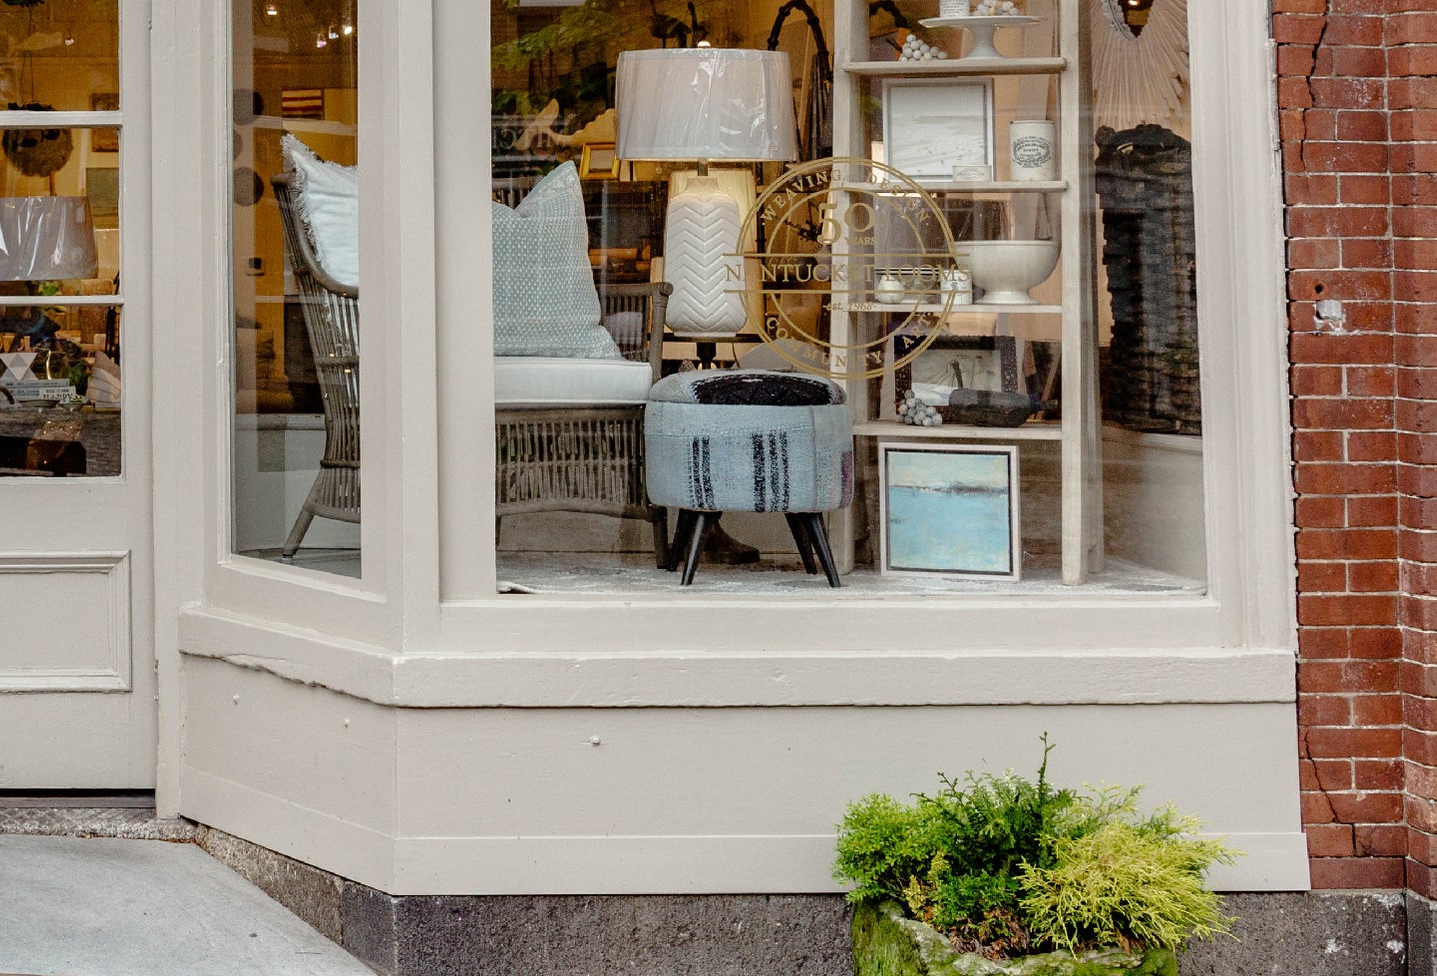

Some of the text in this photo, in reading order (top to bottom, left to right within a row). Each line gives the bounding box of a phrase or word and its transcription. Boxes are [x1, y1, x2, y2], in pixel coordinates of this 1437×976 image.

[761, 170, 842, 222] WEAVING
[817, 202, 875, 245] 50
[724, 264, 875, 282] NNTUCKET
[902, 314, 932, 349] ART
